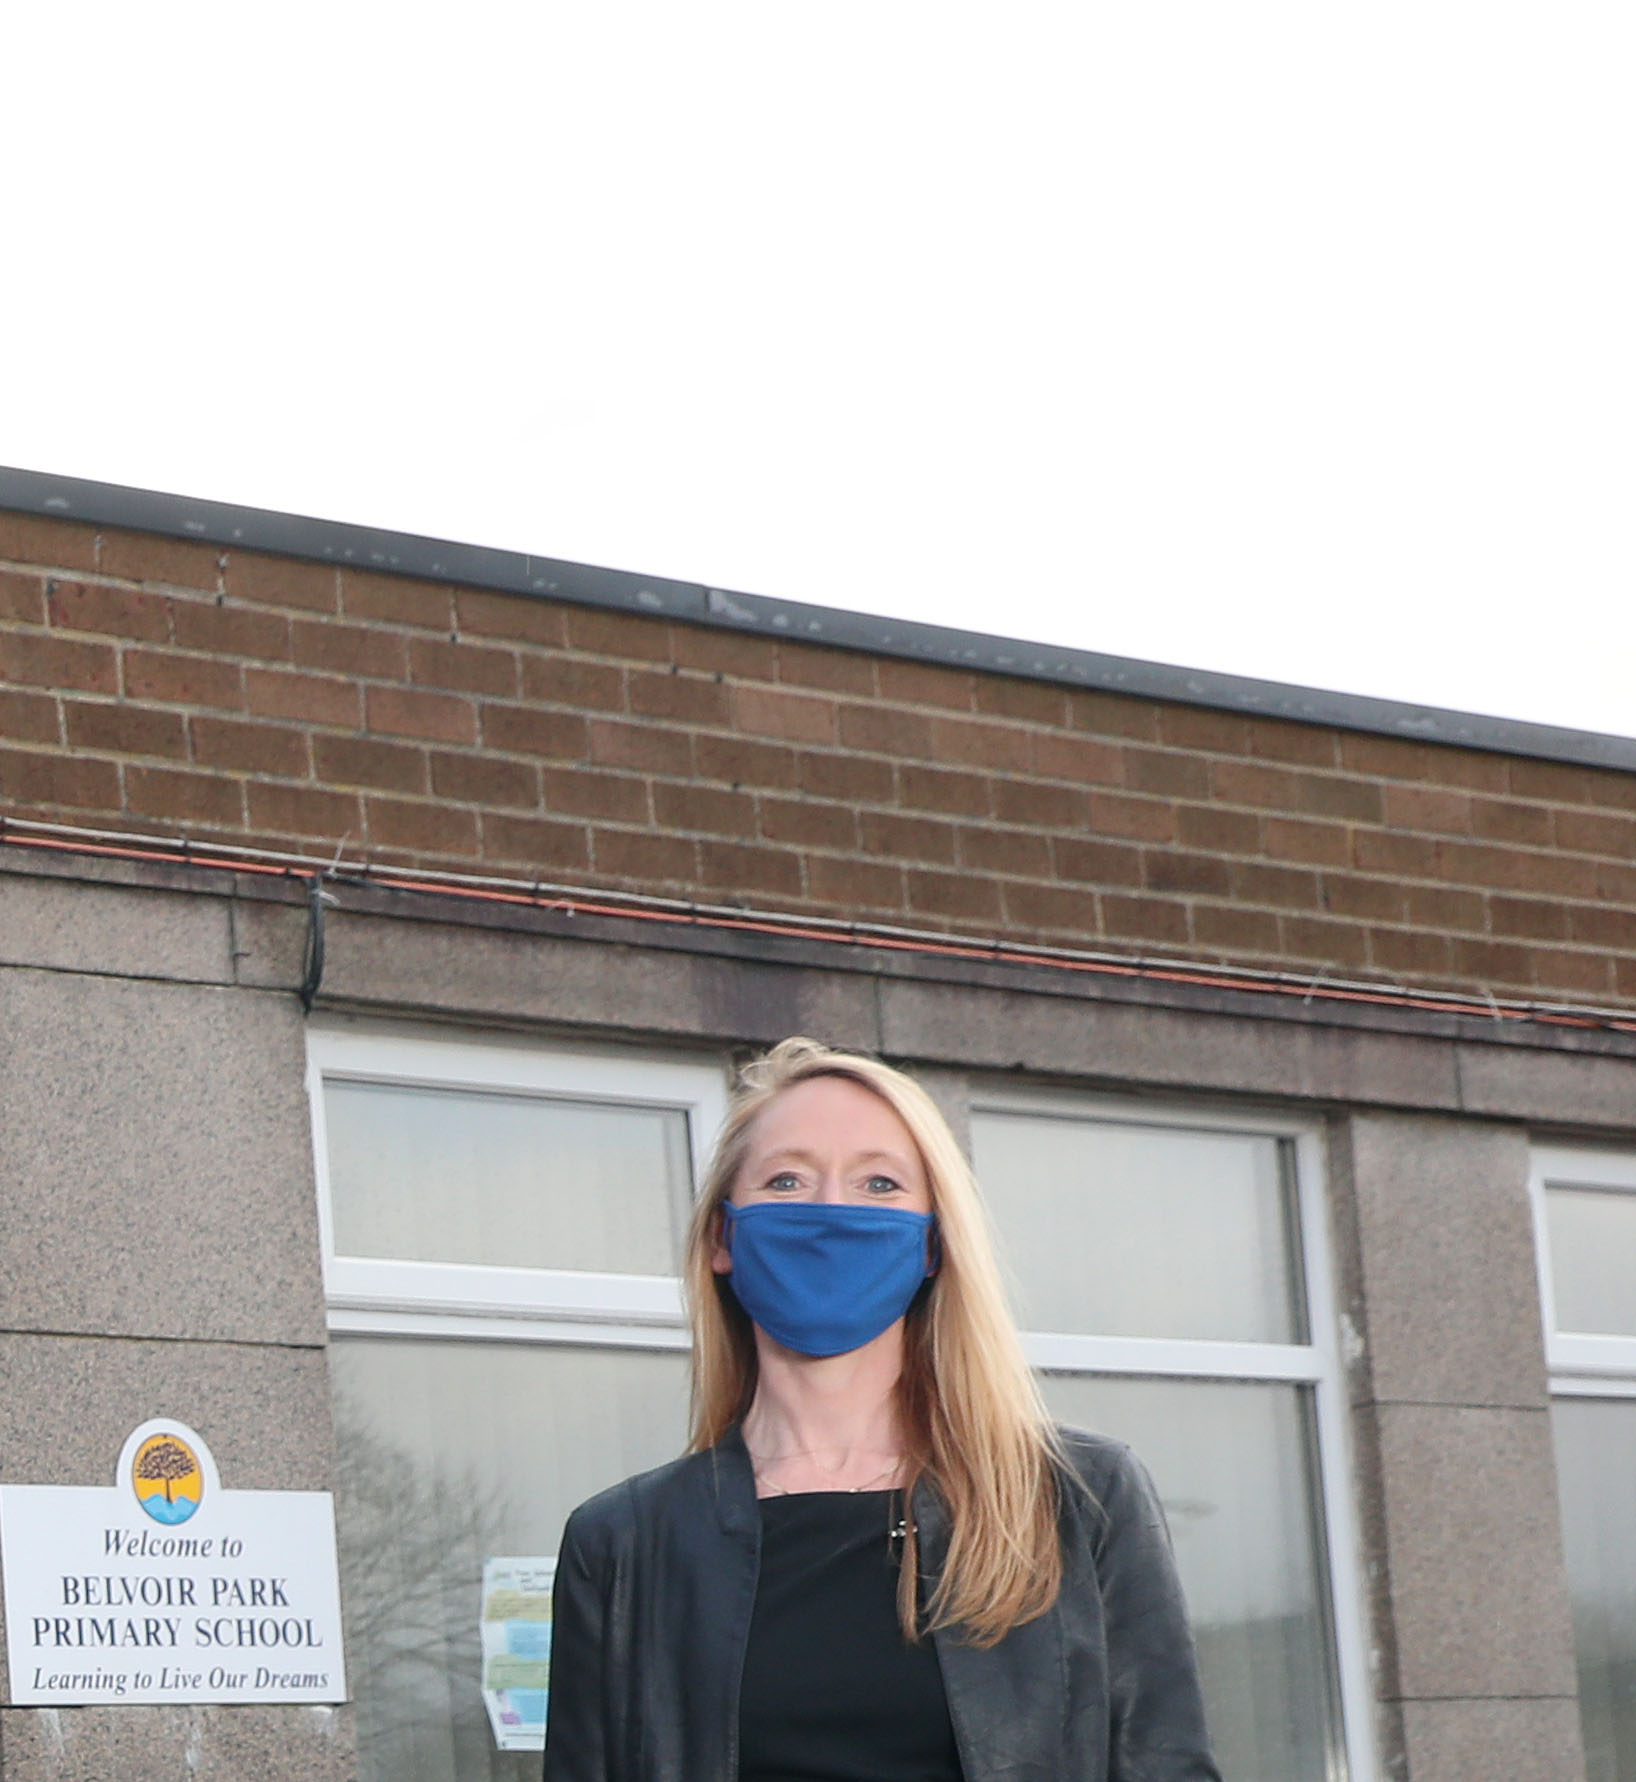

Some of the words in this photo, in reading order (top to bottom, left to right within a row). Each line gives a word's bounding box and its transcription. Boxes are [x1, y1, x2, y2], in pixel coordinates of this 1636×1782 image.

[103, 1529, 213, 1557] Welcome
[221, 1536, 243, 1558] to
[61, 1576, 197, 1607] BELVOIR
[211, 1577, 290, 1607] PARK
[32, 1617, 181, 1648] PRIMARY
[195, 1618, 323, 1648] SCHOOL
[32, 1666, 127, 1694] Learning
[134, 1671, 152, 1690] to
[160, 1666, 202, 1690] Live
[209, 1667, 248, 1689] Our
[254, 1666, 329, 1689] Dreams
